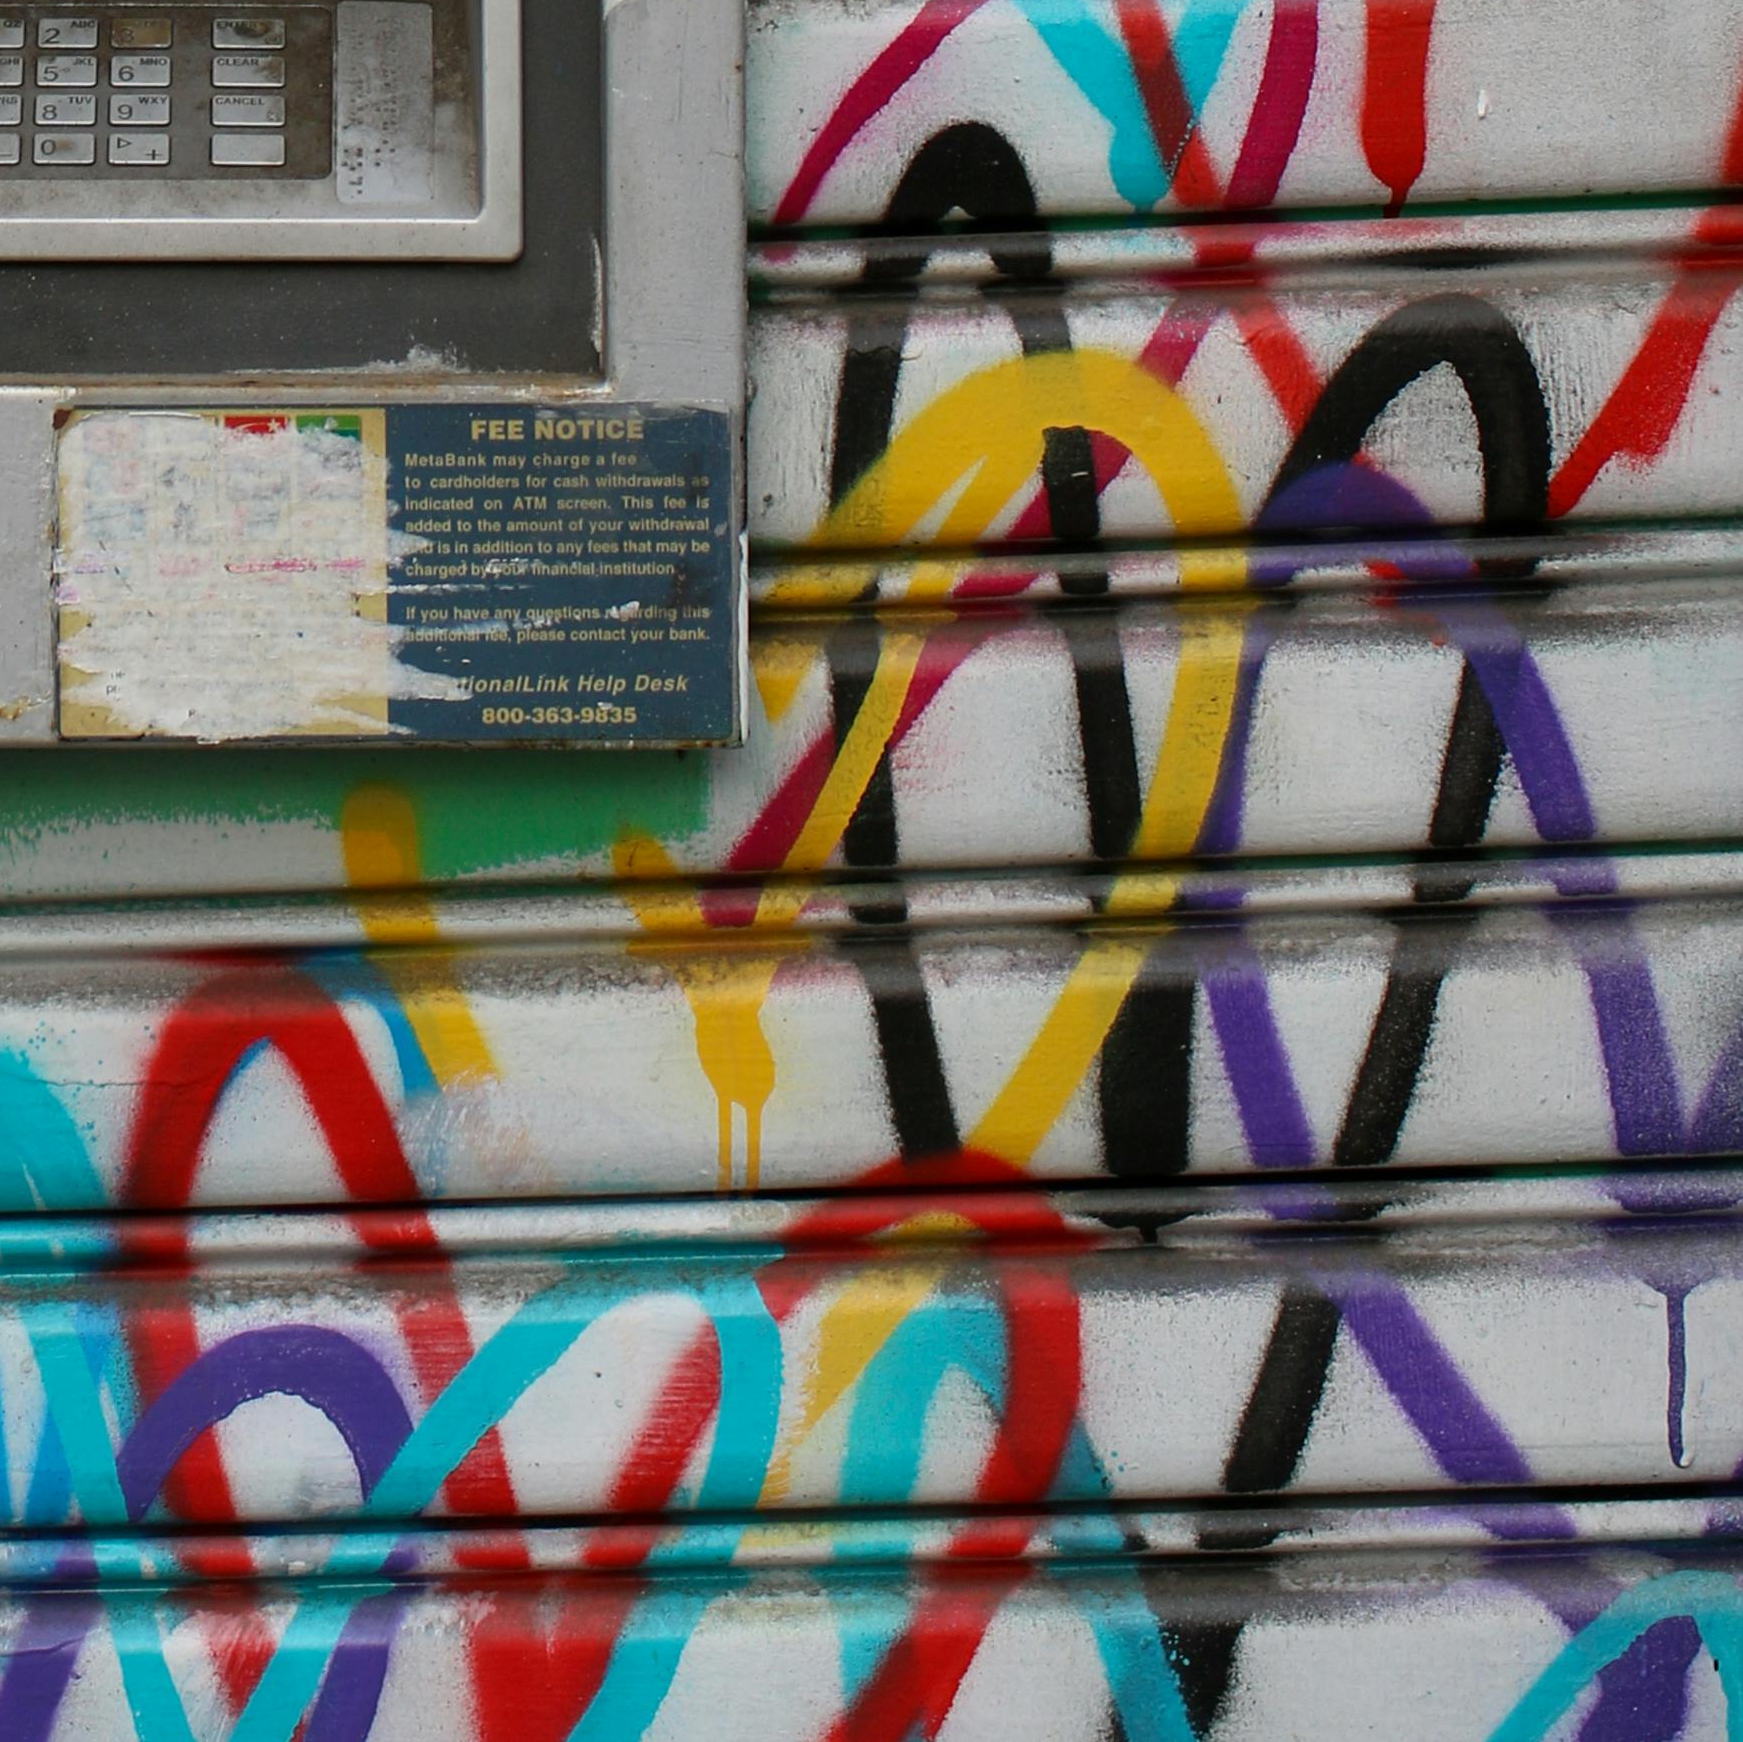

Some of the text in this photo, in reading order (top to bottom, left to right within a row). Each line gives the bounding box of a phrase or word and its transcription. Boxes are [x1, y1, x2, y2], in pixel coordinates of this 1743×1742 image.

[43, 28, 61, 44] 2
[120, 28, 135, 43] 3
[139, 57, 168, 66] MNO
[216, 57, 259, 66] CLEAR
[43, 66, 58, 82] 5
[118, 66, 135, 82] 6
[68, 96, 93, 105] TUV
[138, 96, 168, 105] WXY
[215, 97, 265, 106] CANCEL
[42, 104, 57, 121] 8
[117, 104, 133, 121] 9
[41, 139, 56, 155] 0
[471, 419, 645, 440] FEE NOTICE
[405, 452, 637, 469] MetaBank may charge a fee
[405, 474, 709, 488] to cardholders for cash withdrawals as
[405, 495, 710, 510] indicated on ATM screen. This fee is
[405, 518, 709, 534] added to the amount of your withdrawal
[438, 540, 450, 554] is
[454, 540, 469, 554] in
[473, 540, 533, 554] addition
[538, 541, 552, 554] to
[556, 542, 583, 556] any
[587, 540, 619, 553] fees
[624, 540, 652, 553] that
[656, 541, 687, 556] may
[691, 539, 710, 553] be
[406, 562, 466, 579] charged
[471, 562, 487, 579] by
[532, 561, 594, 575] financial
[600, 562, 674, 575] institution
[405, 606, 416, 620] If
[420, 609, 448, 622] you
[454, 607, 489, 620] have
[494, 609, 521, 622] any
[526, 606, 600, 622] questions
[683, 606, 711, 619] this
[405, 628, 480, 642] additional
[517, 628, 565, 644] please
[570, 627, 626, 641] contact
[630, 629, 664, 644] your
[669, 627, 710, 641] bank.
[578, 674, 626, 696] Help
[634, 674, 689, 692] Desk
[481, 706, 637, 724] 800-363-9835
